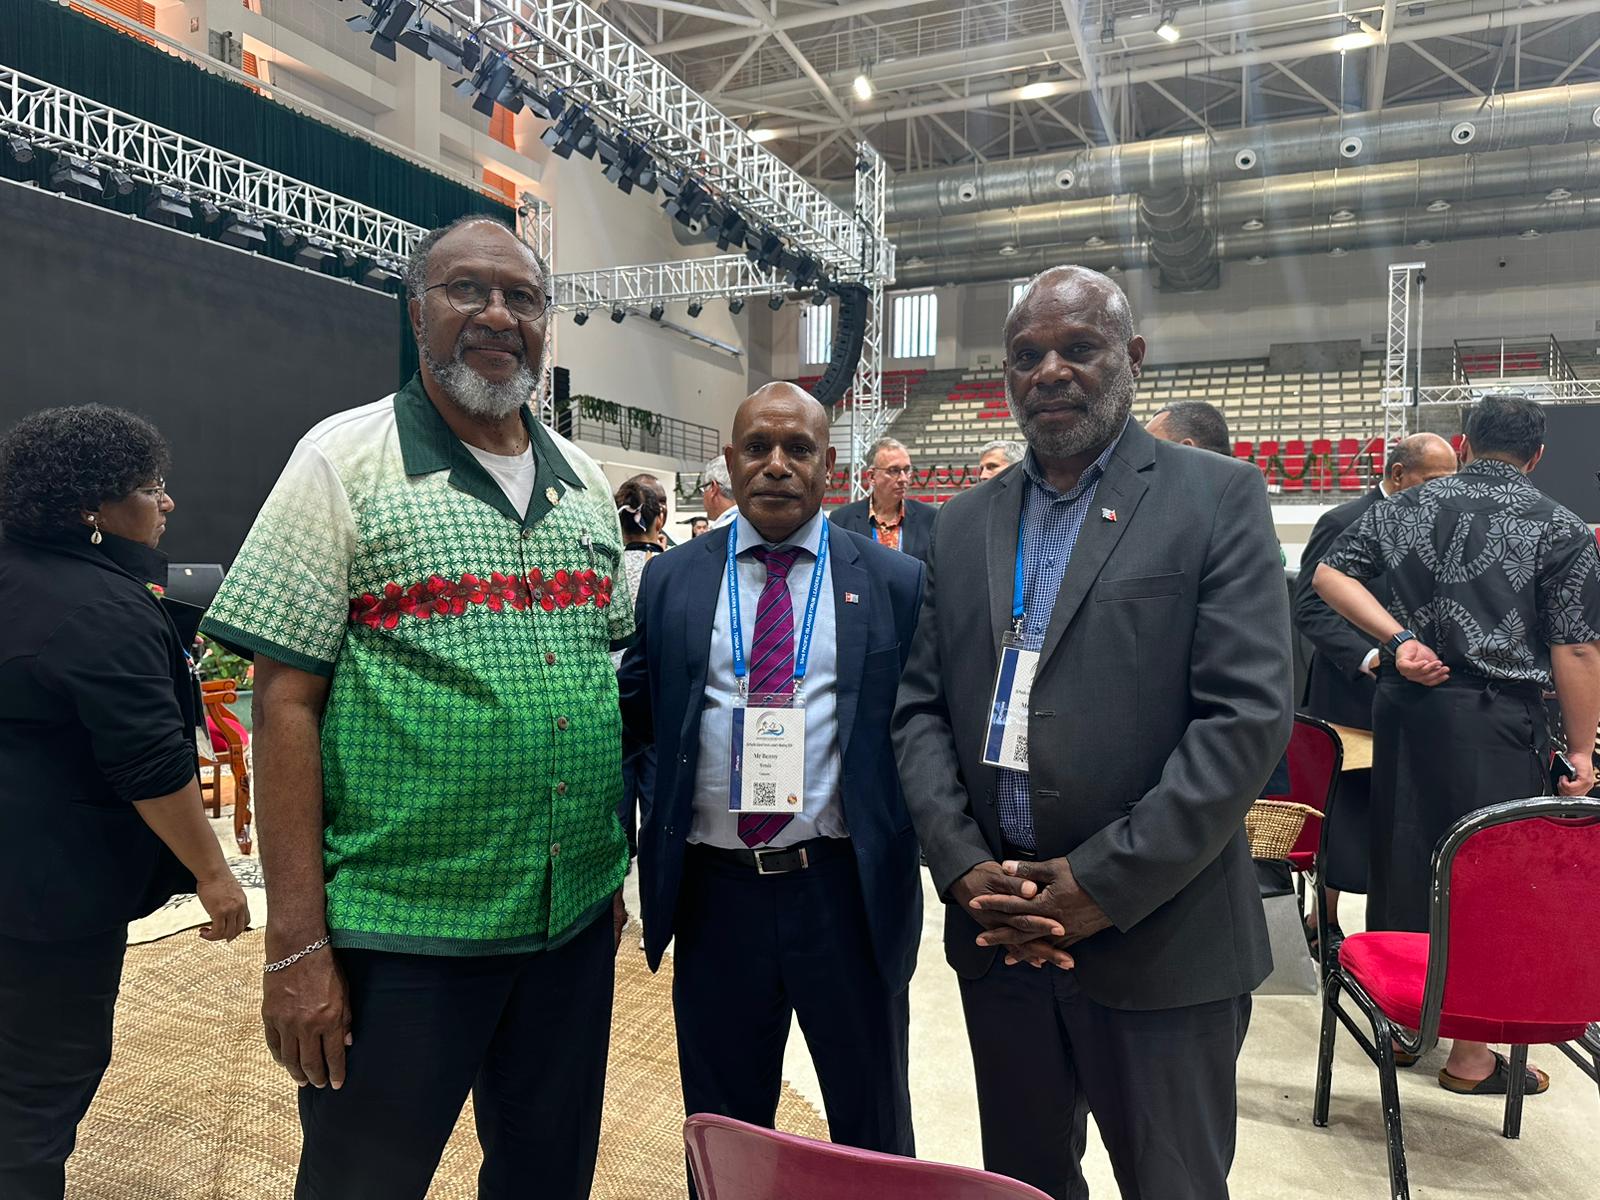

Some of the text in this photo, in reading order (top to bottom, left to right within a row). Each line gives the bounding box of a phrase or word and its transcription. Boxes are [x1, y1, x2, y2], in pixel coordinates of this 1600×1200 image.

[801, 634, 809, 653] PACIFIC
[808, 597, 816, 614] FORUM
[812, 577, 820, 597] LEADERS
